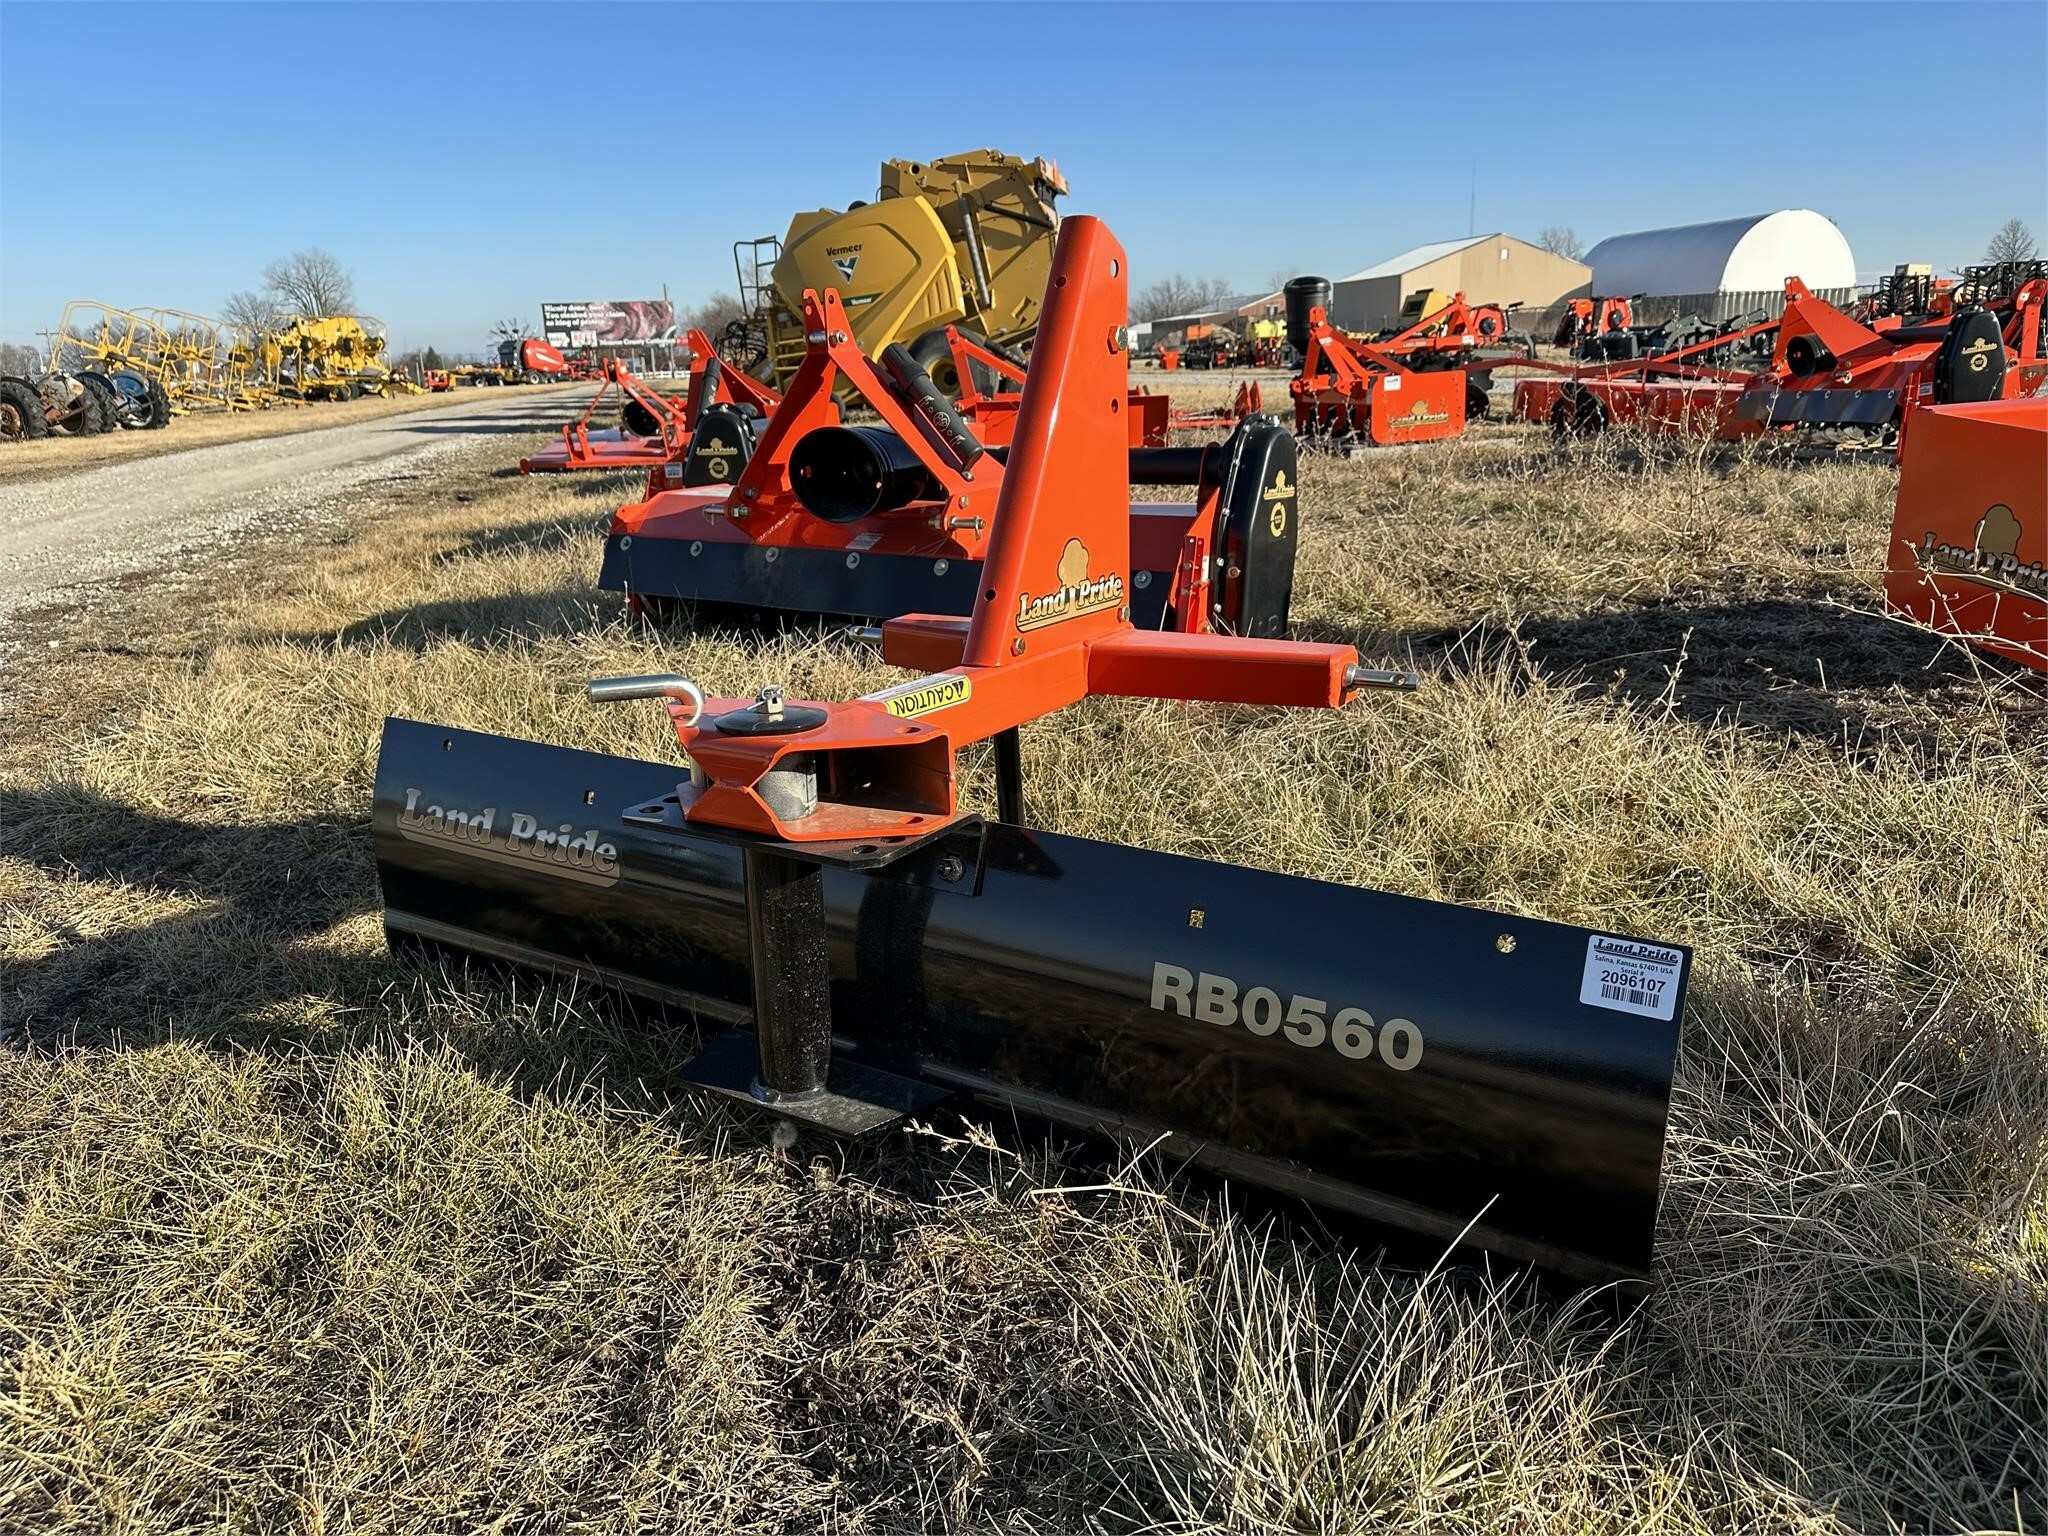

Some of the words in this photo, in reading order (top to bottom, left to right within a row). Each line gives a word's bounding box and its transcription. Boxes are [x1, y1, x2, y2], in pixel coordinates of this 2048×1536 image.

[825, 243, 863, 257] Vermeer
[1018, 585, 1067, 622] Land
[1076, 572, 1123, 608] Pride
[893, 685, 954, 715] CAUTION
[400, 788, 497, 845] Land
[504, 812, 618, 872] Pride
[1594, 938, 1634, 955] Land
[1634, 945, 1679, 964] Pride
[1595, 955, 1615, 965] Salina,
[1616, 958, 1638, 969] Kansas
[1640, 962, 1659, 972] 67401
[1660, 966, 1673, 975] USA
[1621, 967, 1639, 976] Serial
[1601, 970, 1666, 993] 2096107
[1150, 961, 1424, 1071] RB0560
